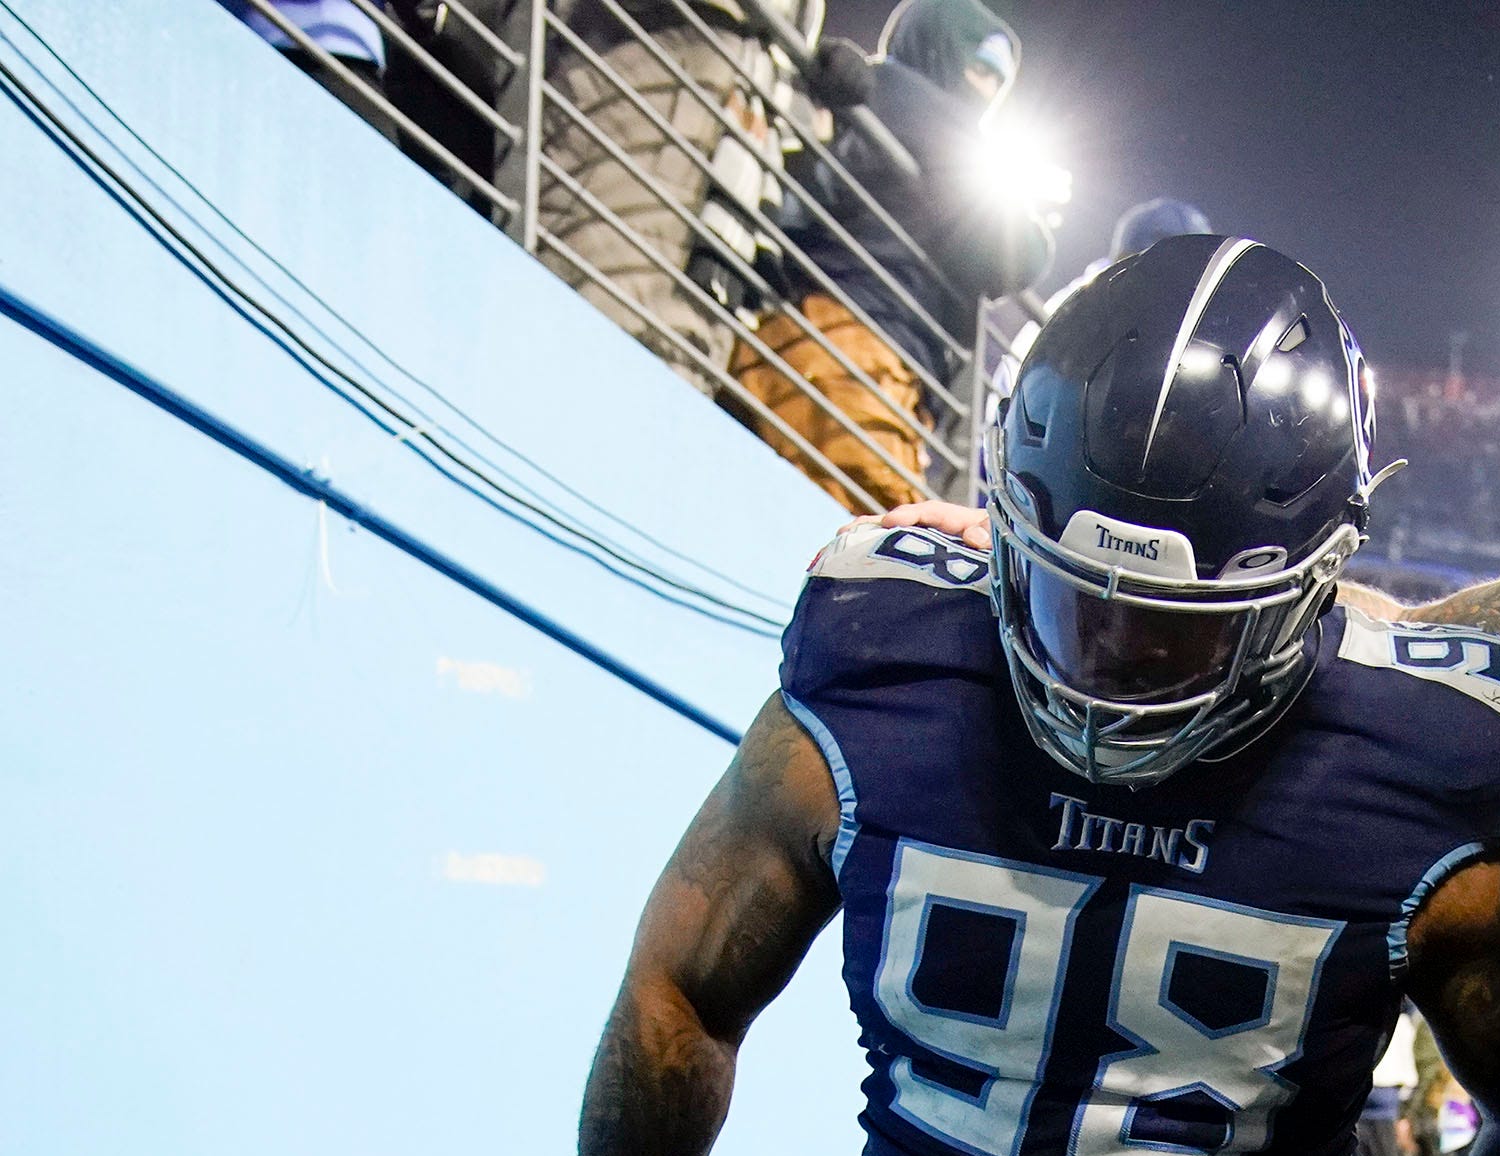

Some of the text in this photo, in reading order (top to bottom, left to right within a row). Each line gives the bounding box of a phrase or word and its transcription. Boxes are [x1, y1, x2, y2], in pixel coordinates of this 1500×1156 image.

[866, 525, 991, 586] 8
[1095, 523, 1160, 561] TITANS
[1049, 791, 1217, 874] TITANS
